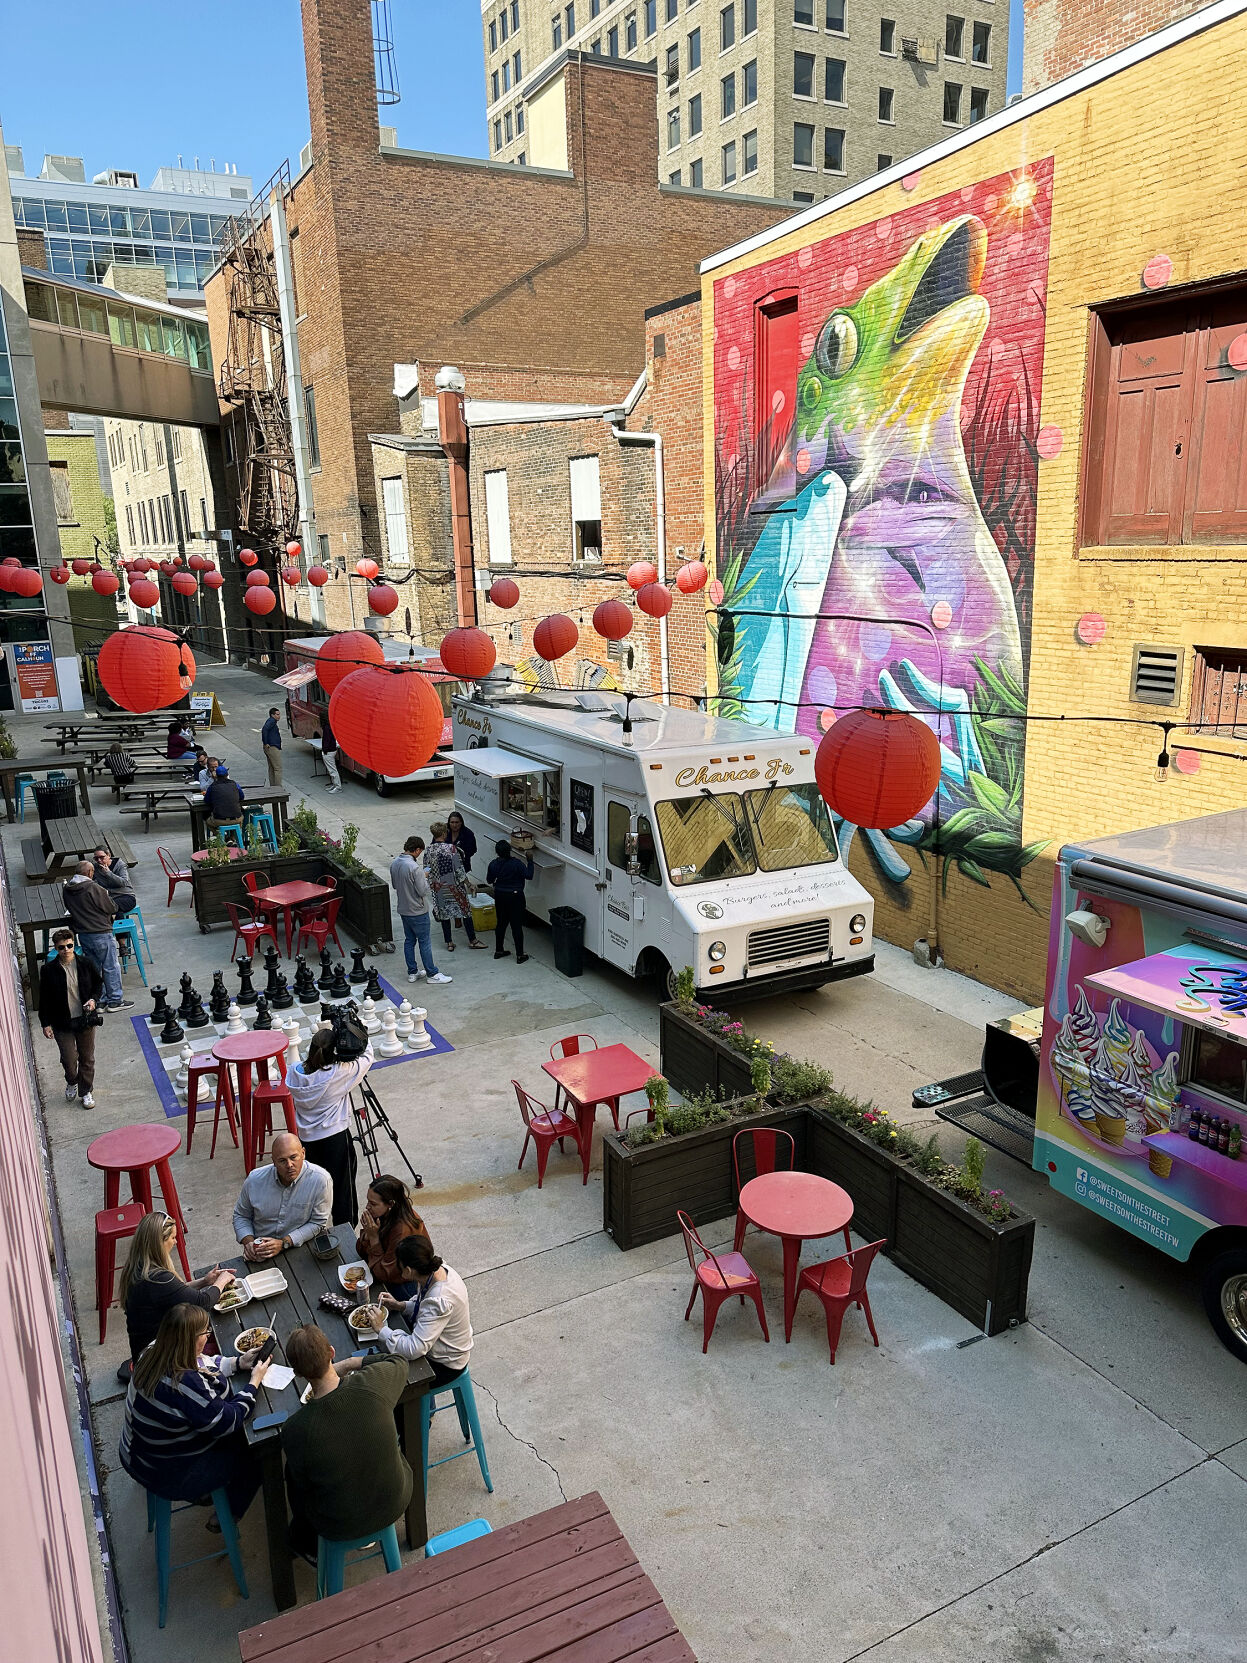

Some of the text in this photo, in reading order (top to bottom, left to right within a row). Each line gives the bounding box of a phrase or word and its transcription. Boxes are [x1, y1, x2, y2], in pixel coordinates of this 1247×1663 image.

[675, 758, 795, 788] Chance Jr
[1088, 1189, 1180, 1248] @SWEETSONTHESTREETFW
[1089, 1174, 1171, 1227] @SWEETSONTHESTREET
